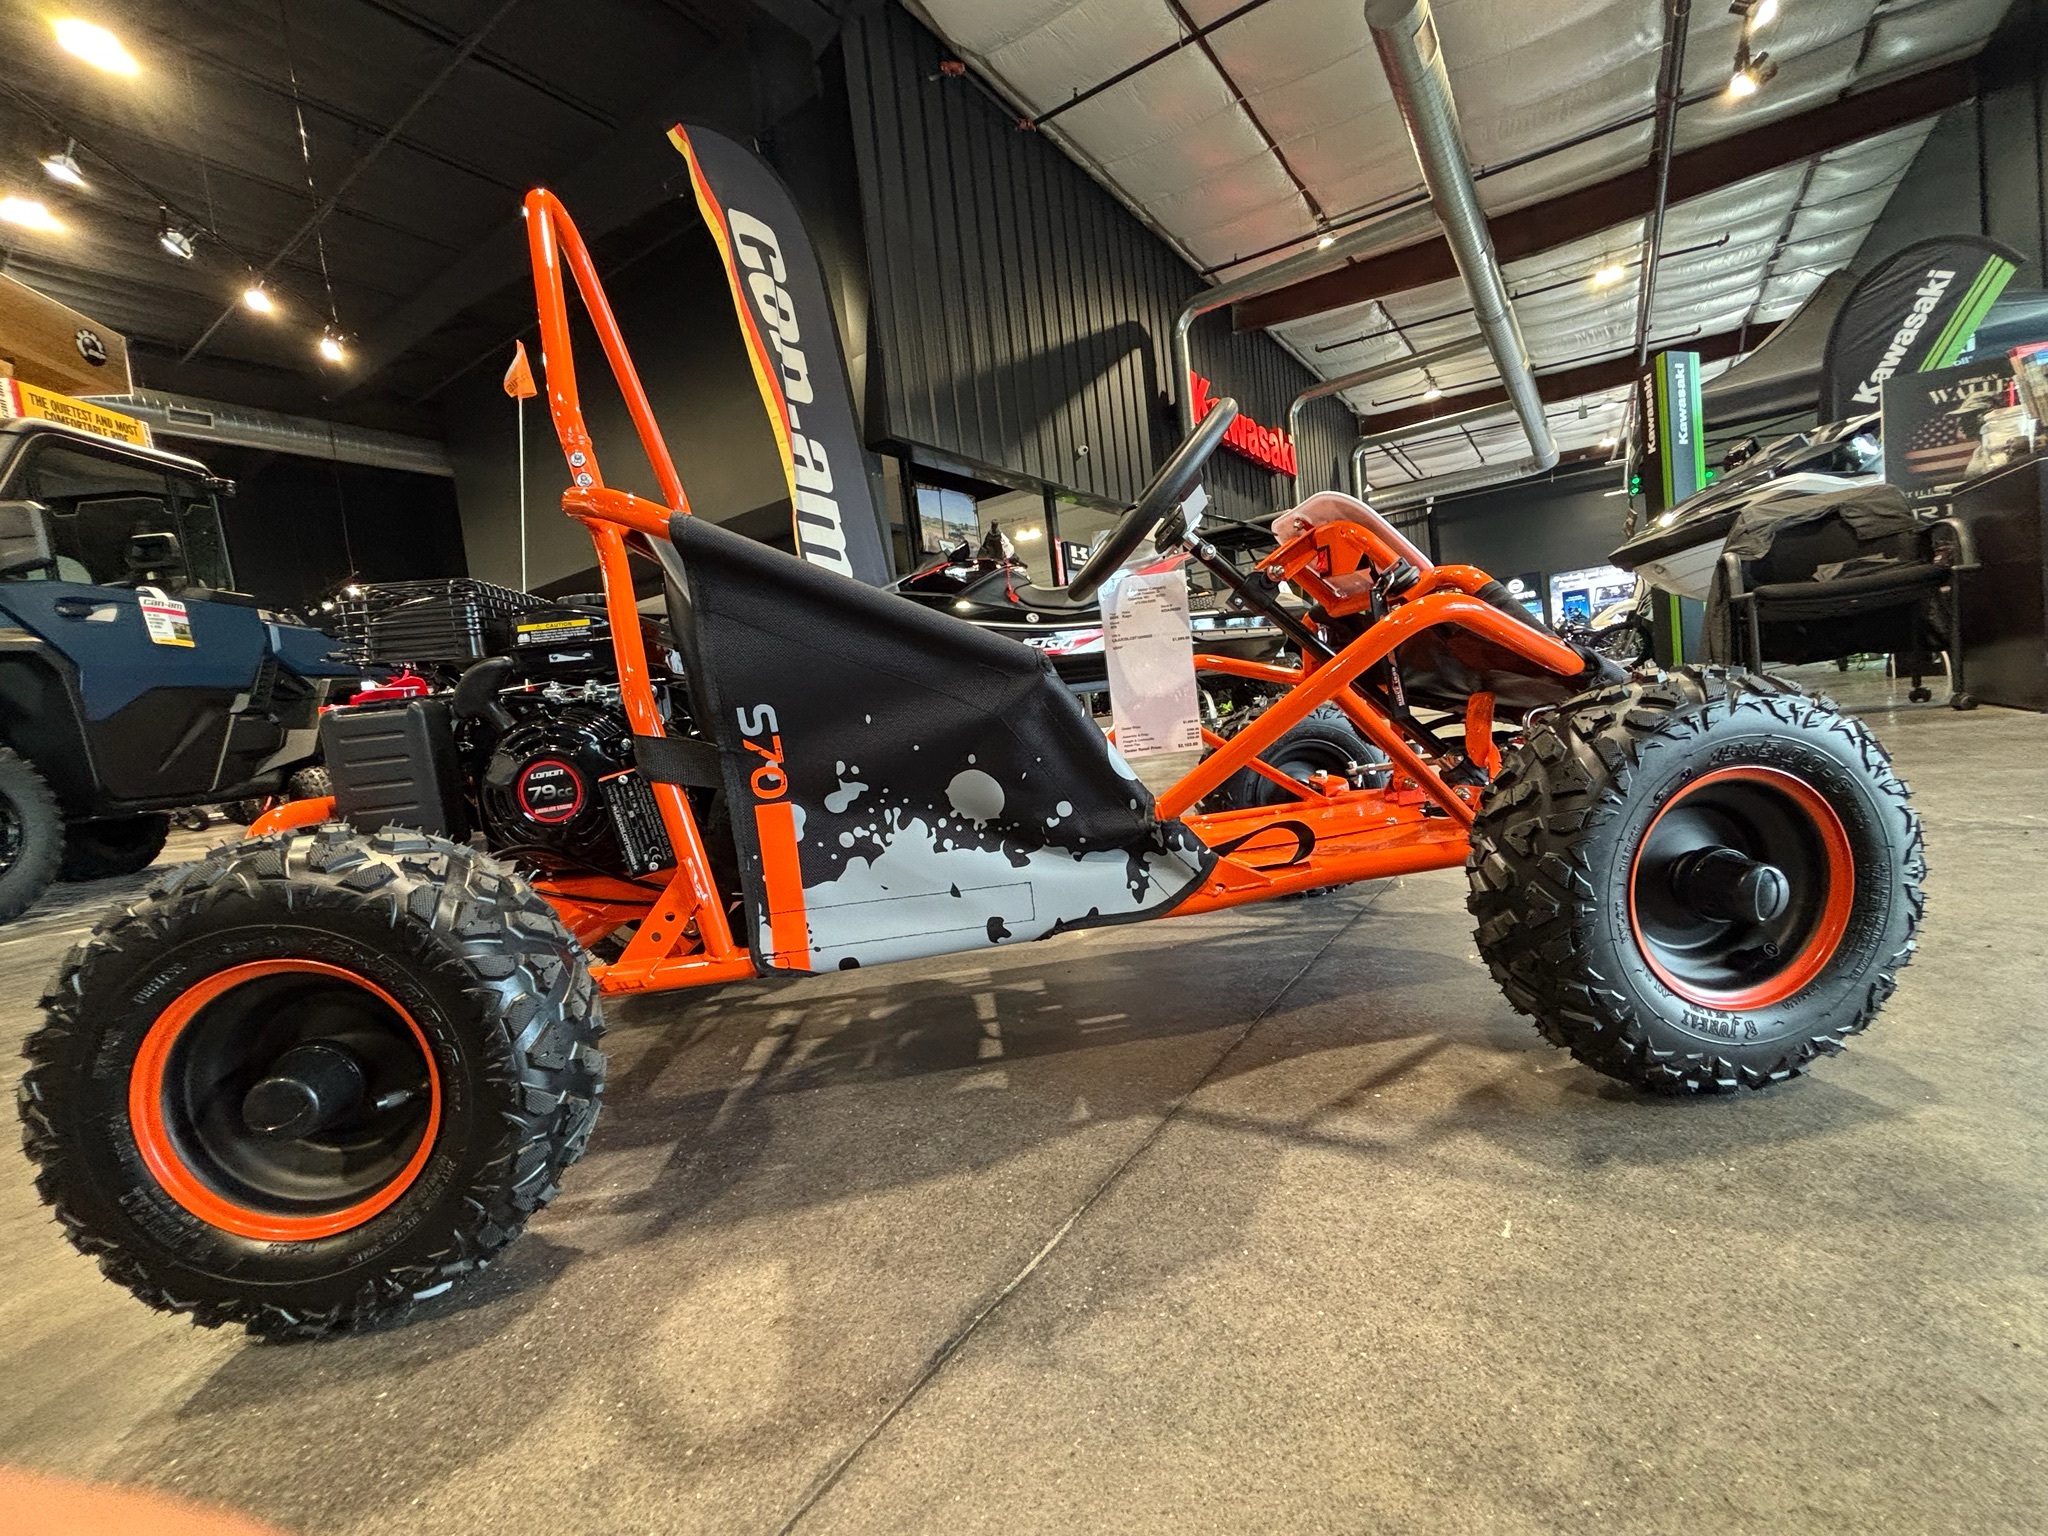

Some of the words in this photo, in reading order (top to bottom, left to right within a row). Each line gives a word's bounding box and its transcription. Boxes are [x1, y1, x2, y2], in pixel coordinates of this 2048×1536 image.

[1851, 270, 1956, 404] Kawasaki
[27, 392, 50, 410] THE
[50, 398, 93, 423] QUIETEST
[95, 413, 113, 429] AND
[114, 420, 139, 437] MOST
[728, 208, 853, 579] can-am
[1190, 369, 1298, 476] Kwasaki
[1643, 373, 1657, 454] Kawasaki
[1674, 363, 1688, 444] Kawasaki
[143, 598, 183, 610] can-am
[545, 621, 573, 629] CAUTION
[736, 703, 788, 800] S70
